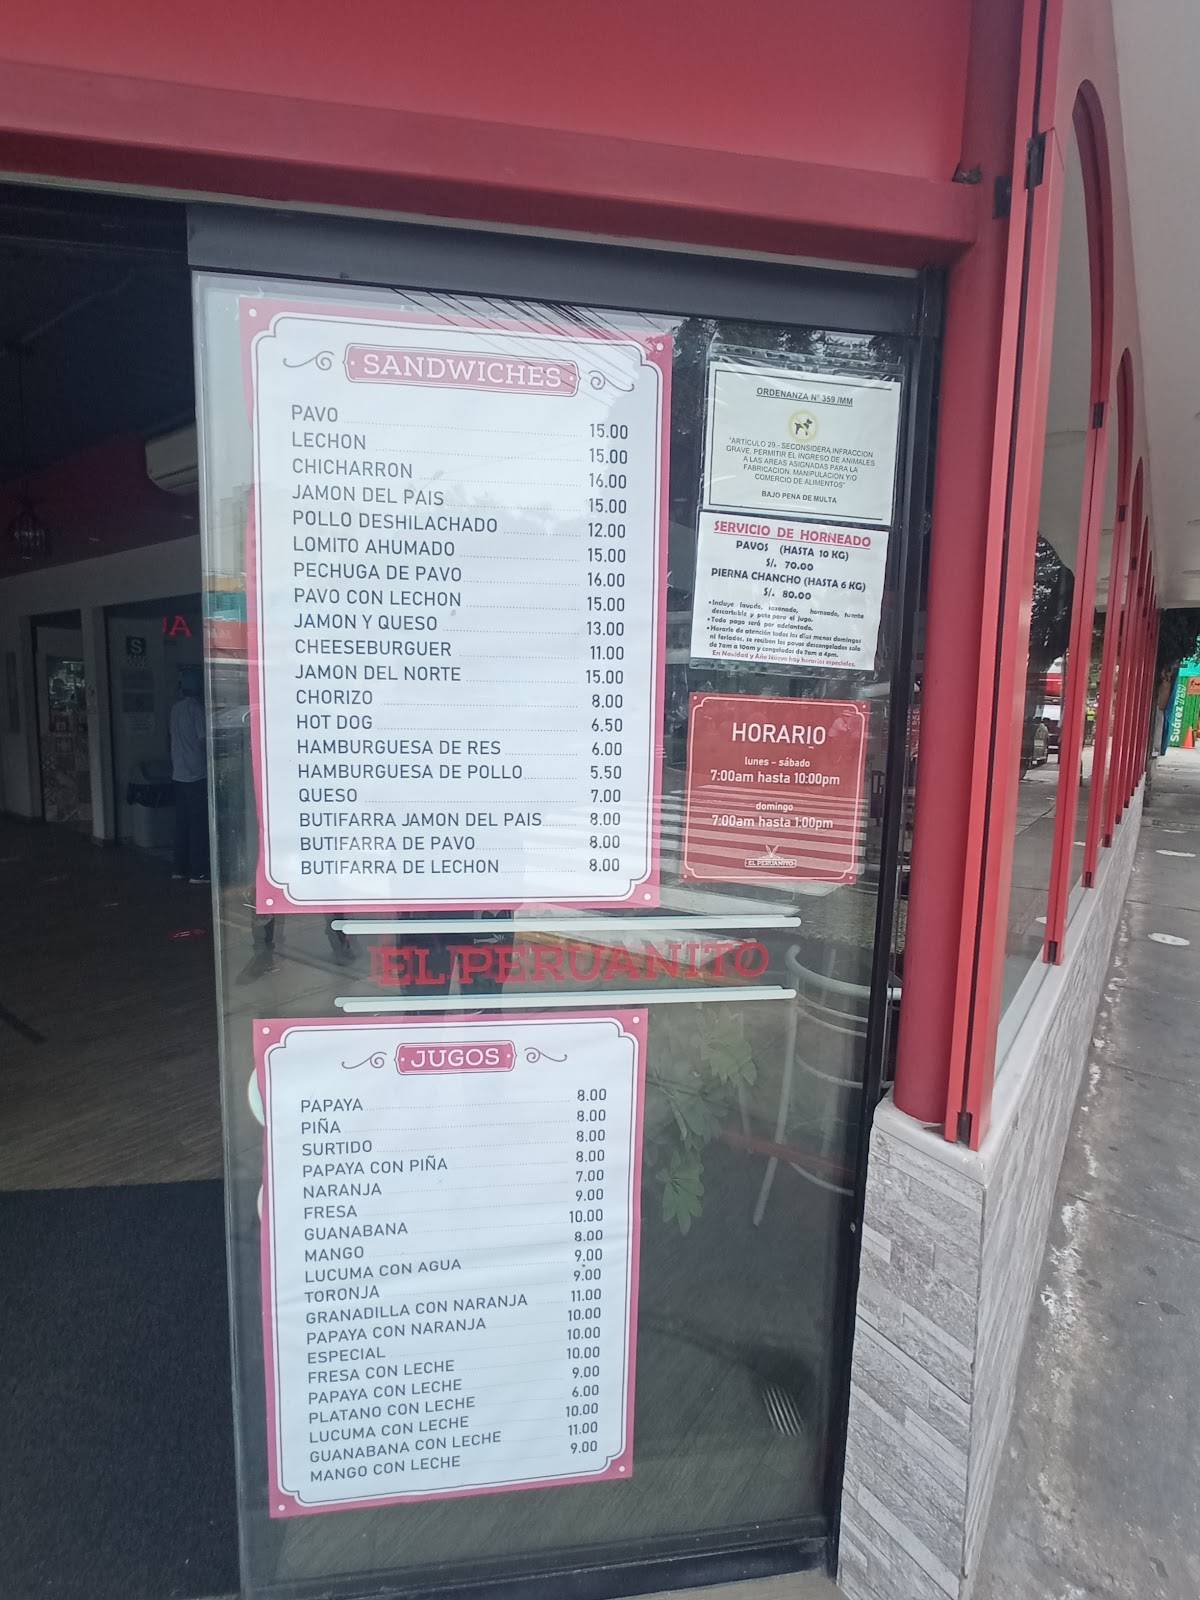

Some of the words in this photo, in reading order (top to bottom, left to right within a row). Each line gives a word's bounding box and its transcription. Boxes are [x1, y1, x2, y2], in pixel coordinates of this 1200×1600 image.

[364, 354, 561, 387] SANDWICHES
[757, 388, 808, 400] ORDENANZA
[292, 404, 338, 422] PAVO
[590, 424, 628, 440] 15.00
[292, 431, 366, 450] LECHON
[589, 448, 628, 464] 15.00
[292, 458, 412, 478] CHICHARRON
[589, 473, 626, 489] 16.00
[292, 484, 355, 502] JAMON
[363, 487, 398, 504] DEL
[404, 489, 444, 506] PAIS
[589, 498, 626, 514] 15.00
[814, 495, 836, 503] MULTA
[293, 510, 351, 527] POLLO
[359, 512, 497, 533] DESHILACHADO
[588, 522, 625, 538] 12.00
[714, 520, 770, 538] SERVICIO
[777, 528, 794, 539] DE
[800, 530, 871, 547] HORNEADO
[294, 536, 358, 553] LOMITO
[365, 539, 454, 556] AHUMADO
[588, 548, 626, 563] 15.00
[736, 540, 768, 552] PAVOS
[780, 545, 814, 557] (HASTA
[819, 549, 828, 558] 10
[831, 550, 849, 561] KG)
[294, 562, 380, 580] PECHUGA
[387, 565, 409, 580] DE
[416, 566, 462, 582] PAVO
[588, 572, 625, 588] 16.00
[785, 561, 814, 571] 70.00
[711, 568, 748, 580] PIERNA
[751, 572, 800, 584] CHANCHO
[804, 576, 838, 588] (HASTA
[840, 581, 846, 589] 6
[849, 581, 866, 592] KG)
[782, 591, 811, 600] 80.00
[294, 613, 356, 629] JAMON
[362, 614, 372, 630] Y
[378, 615, 437, 630] QUESO
[587, 621, 624, 636] 13.00
[296, 639, 451, 656] CHEESEBURGUER
[590, 646, 624, 660] 11.00
[296, 690, 372, 704] CHORIZO
[592, 694, 623, 708] 8.00
[297, 714, 332, 729] HOT
[337, 715, 372, 730] DOG
[592, 718, 622, 732] 6.50
[732, 723, 826, 744] HORARIO
[298, 739, 433, 754] HAMBURGUESA
[440, 740, 462, 754] DE
[468, 740, 500, 755] RES
[592, 742, 622, 756] 6.00
[745, 757, 769, 766] lunes
[779, 757, 810, 768] sábado
[710, 770, 753, 782] 7:00am
[758, 772, 790, 784] hasta
[794, 773, 840, 787] 10:00pm
[299, 788, 357, 802] QUESO
[590, 789, 621, 803] 7.00
[756, 802, 793, 812] domingo
[300, 812, 397, 827] BUTIFARRA
[402, 812, 459, 826] JAMON
[466, 812, 498, 826] DEL
[504, 812, 542, 826] PAIS
[590, 812, 620, 826] 8.00
[712, 815, 754, 827] 7:00am
[758, 816, 790, 828] hasta
[795, 817, 833, 830] 1:00pm
[302, 860, 397, 875] BUTIFARRA
[403, 860, 424, 874] DE
[431, 859, 498, 874] LECHON
[589, 858, 620, 872] 8.00
[378, 946, 448, 986] EL
[455, 940, 769, 985] PERUANITO
[410, 1047, 500, 1068] JUGOS
[301, 1098, 363, 1113] PAPAYA
[577, 1088, 606, 1102] 8.00
[302, 1118, 341, 1134] PIÑA
[577, 1109, 606, 1122] 8.00
[302, 1140, 372, 1156] SURTIDO
[576, 1129, 605, 1142] 8.00
[303, 1162, 364, 1178] PAPAYA
[370, 1160, 403, 1174] CON
[410, 1155, 448, 1172] PIÑA
[576, 1149, 604, 1162] 8.00
[304, 1182, 382, 1199] NARANJA
[576, 1169, 604, 1183] 7.00
[304, 1205, 357, 1220] FRESA
[576, 1188, 604, 1202] 9.00
[304, 1222, 408, 1240] GUANABANA
[569, 1208, 603, 1223] 10.00
[305, 1246, 364, 1262] MANGO
[574, 1230, 603, 1242] 8.00
[305, 1266, 374, 1283] LUCUMA
[379, 1262, 412, 1276] CON
[418, 1259, 461, 1272] AGUA
[574, 1248, 602, 1262] 9.00
[304, 1285, 380, 1303] TORONJA
[574, 1268, 601, 1282] 9.00
[306, 1304, 410, 1324] GRANADILLA
[416, 1300, 447, 1314] CON
[454, 1294, 528, 1312] NARANJA
[571, 1288, 601, 1302] 11.00
[308, 1346, 386, 1364] ESPECIAL
[568, 1326, 600, 1340] 10.00
[309, 1406, 381, 1424] PLATANO
[388, 1402, 419, 1416] CON
[426, 1396, 475, 1413] LECHE
[572, 1384, 599, 1398] 6.00
[311, 1466, 367, 1482] MANGO
[374, 1460, 404, 1475] CON
[411, 1456, 460, 1470] LECHE
[570, 1440, 598, 1454] 9.00
